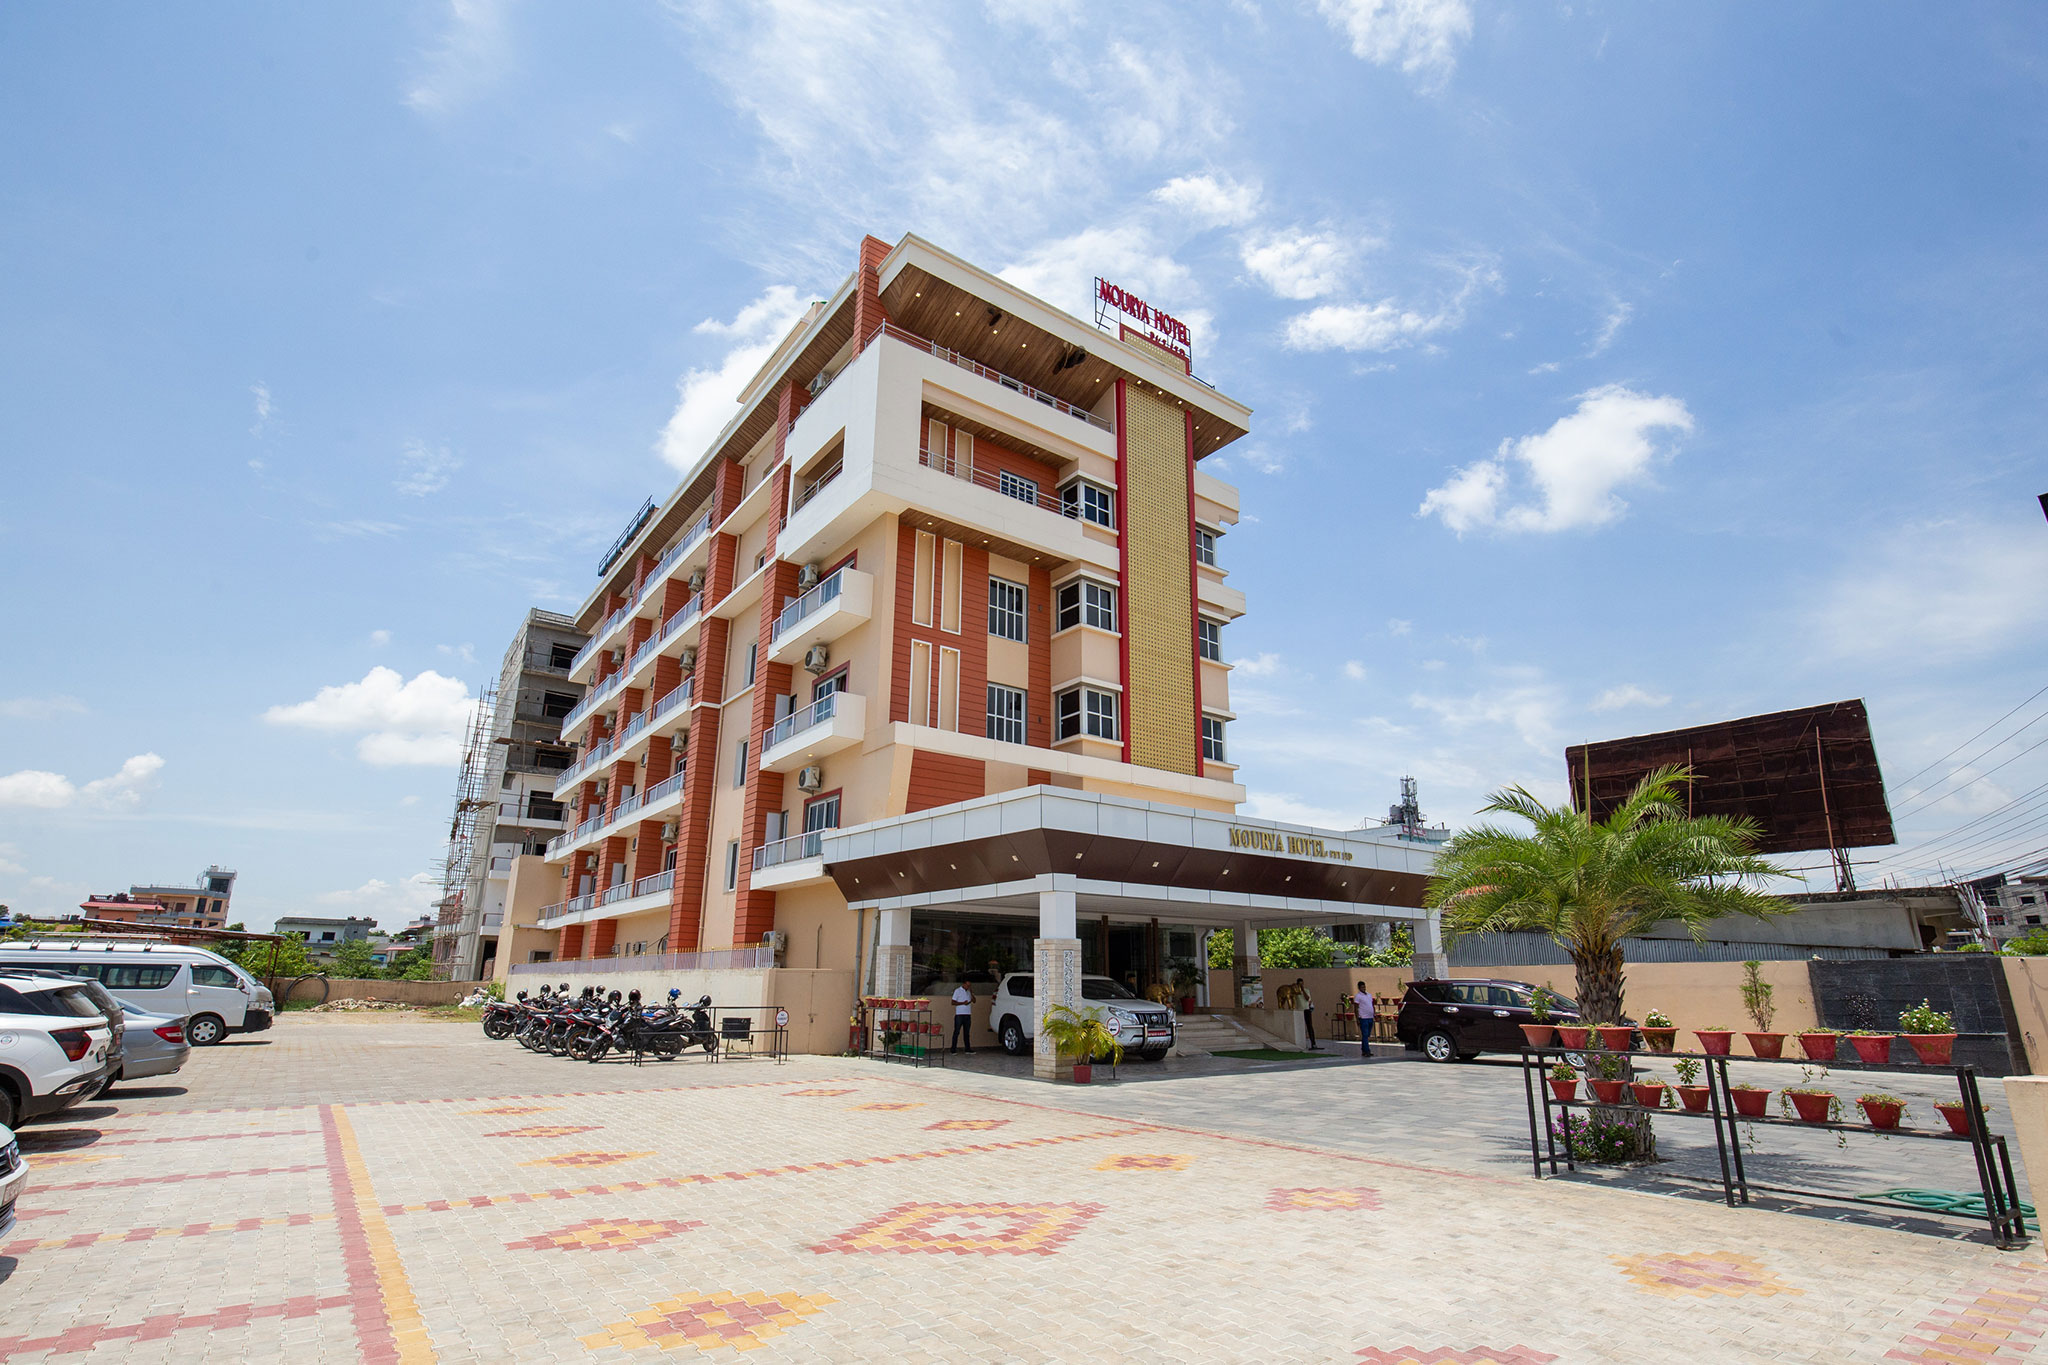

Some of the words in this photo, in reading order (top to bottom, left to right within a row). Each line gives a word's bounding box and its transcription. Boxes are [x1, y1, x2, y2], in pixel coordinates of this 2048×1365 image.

[1099, 277, 1150, 325] MOURYA
[1154, 308, 1191, 347] HOTEL
[1229, 828, 1284, 852] MOURYA
[1287, 836, 1328, 859] HOTEL
